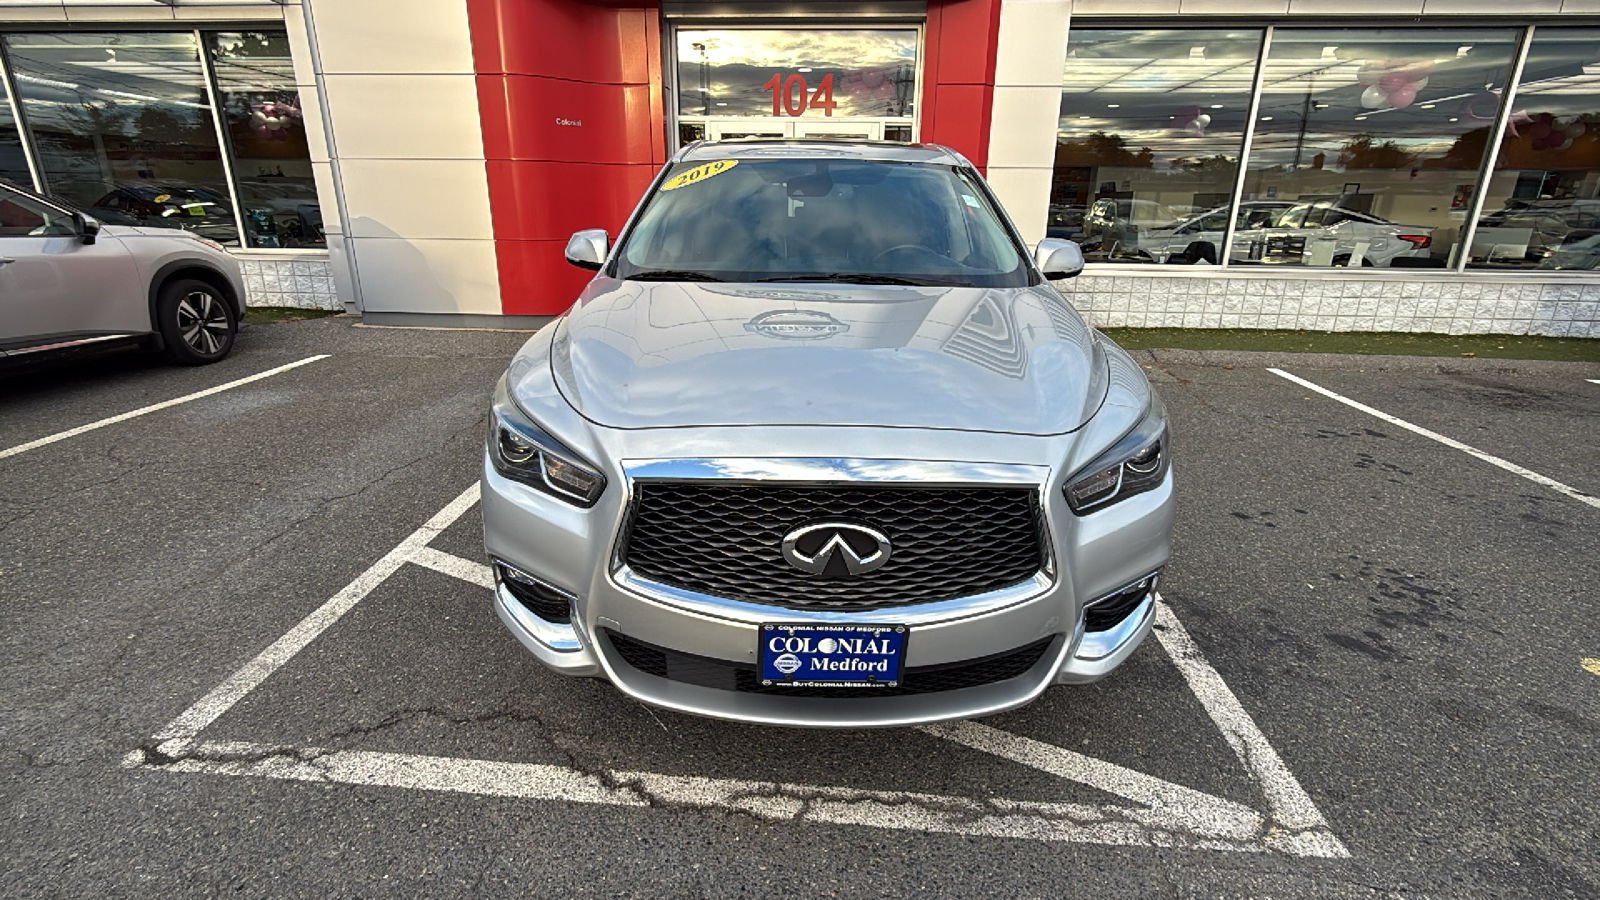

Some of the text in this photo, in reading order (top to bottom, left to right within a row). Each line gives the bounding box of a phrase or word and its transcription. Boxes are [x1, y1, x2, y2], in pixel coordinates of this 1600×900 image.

[763, 73, 837, 117] 104
[556, 117, 582, 127] Colonial
[677, 162, 725, 186] 2019
[769, 636, 896, 655] COLONIAL
[810, 657, 888, 672] Medford
